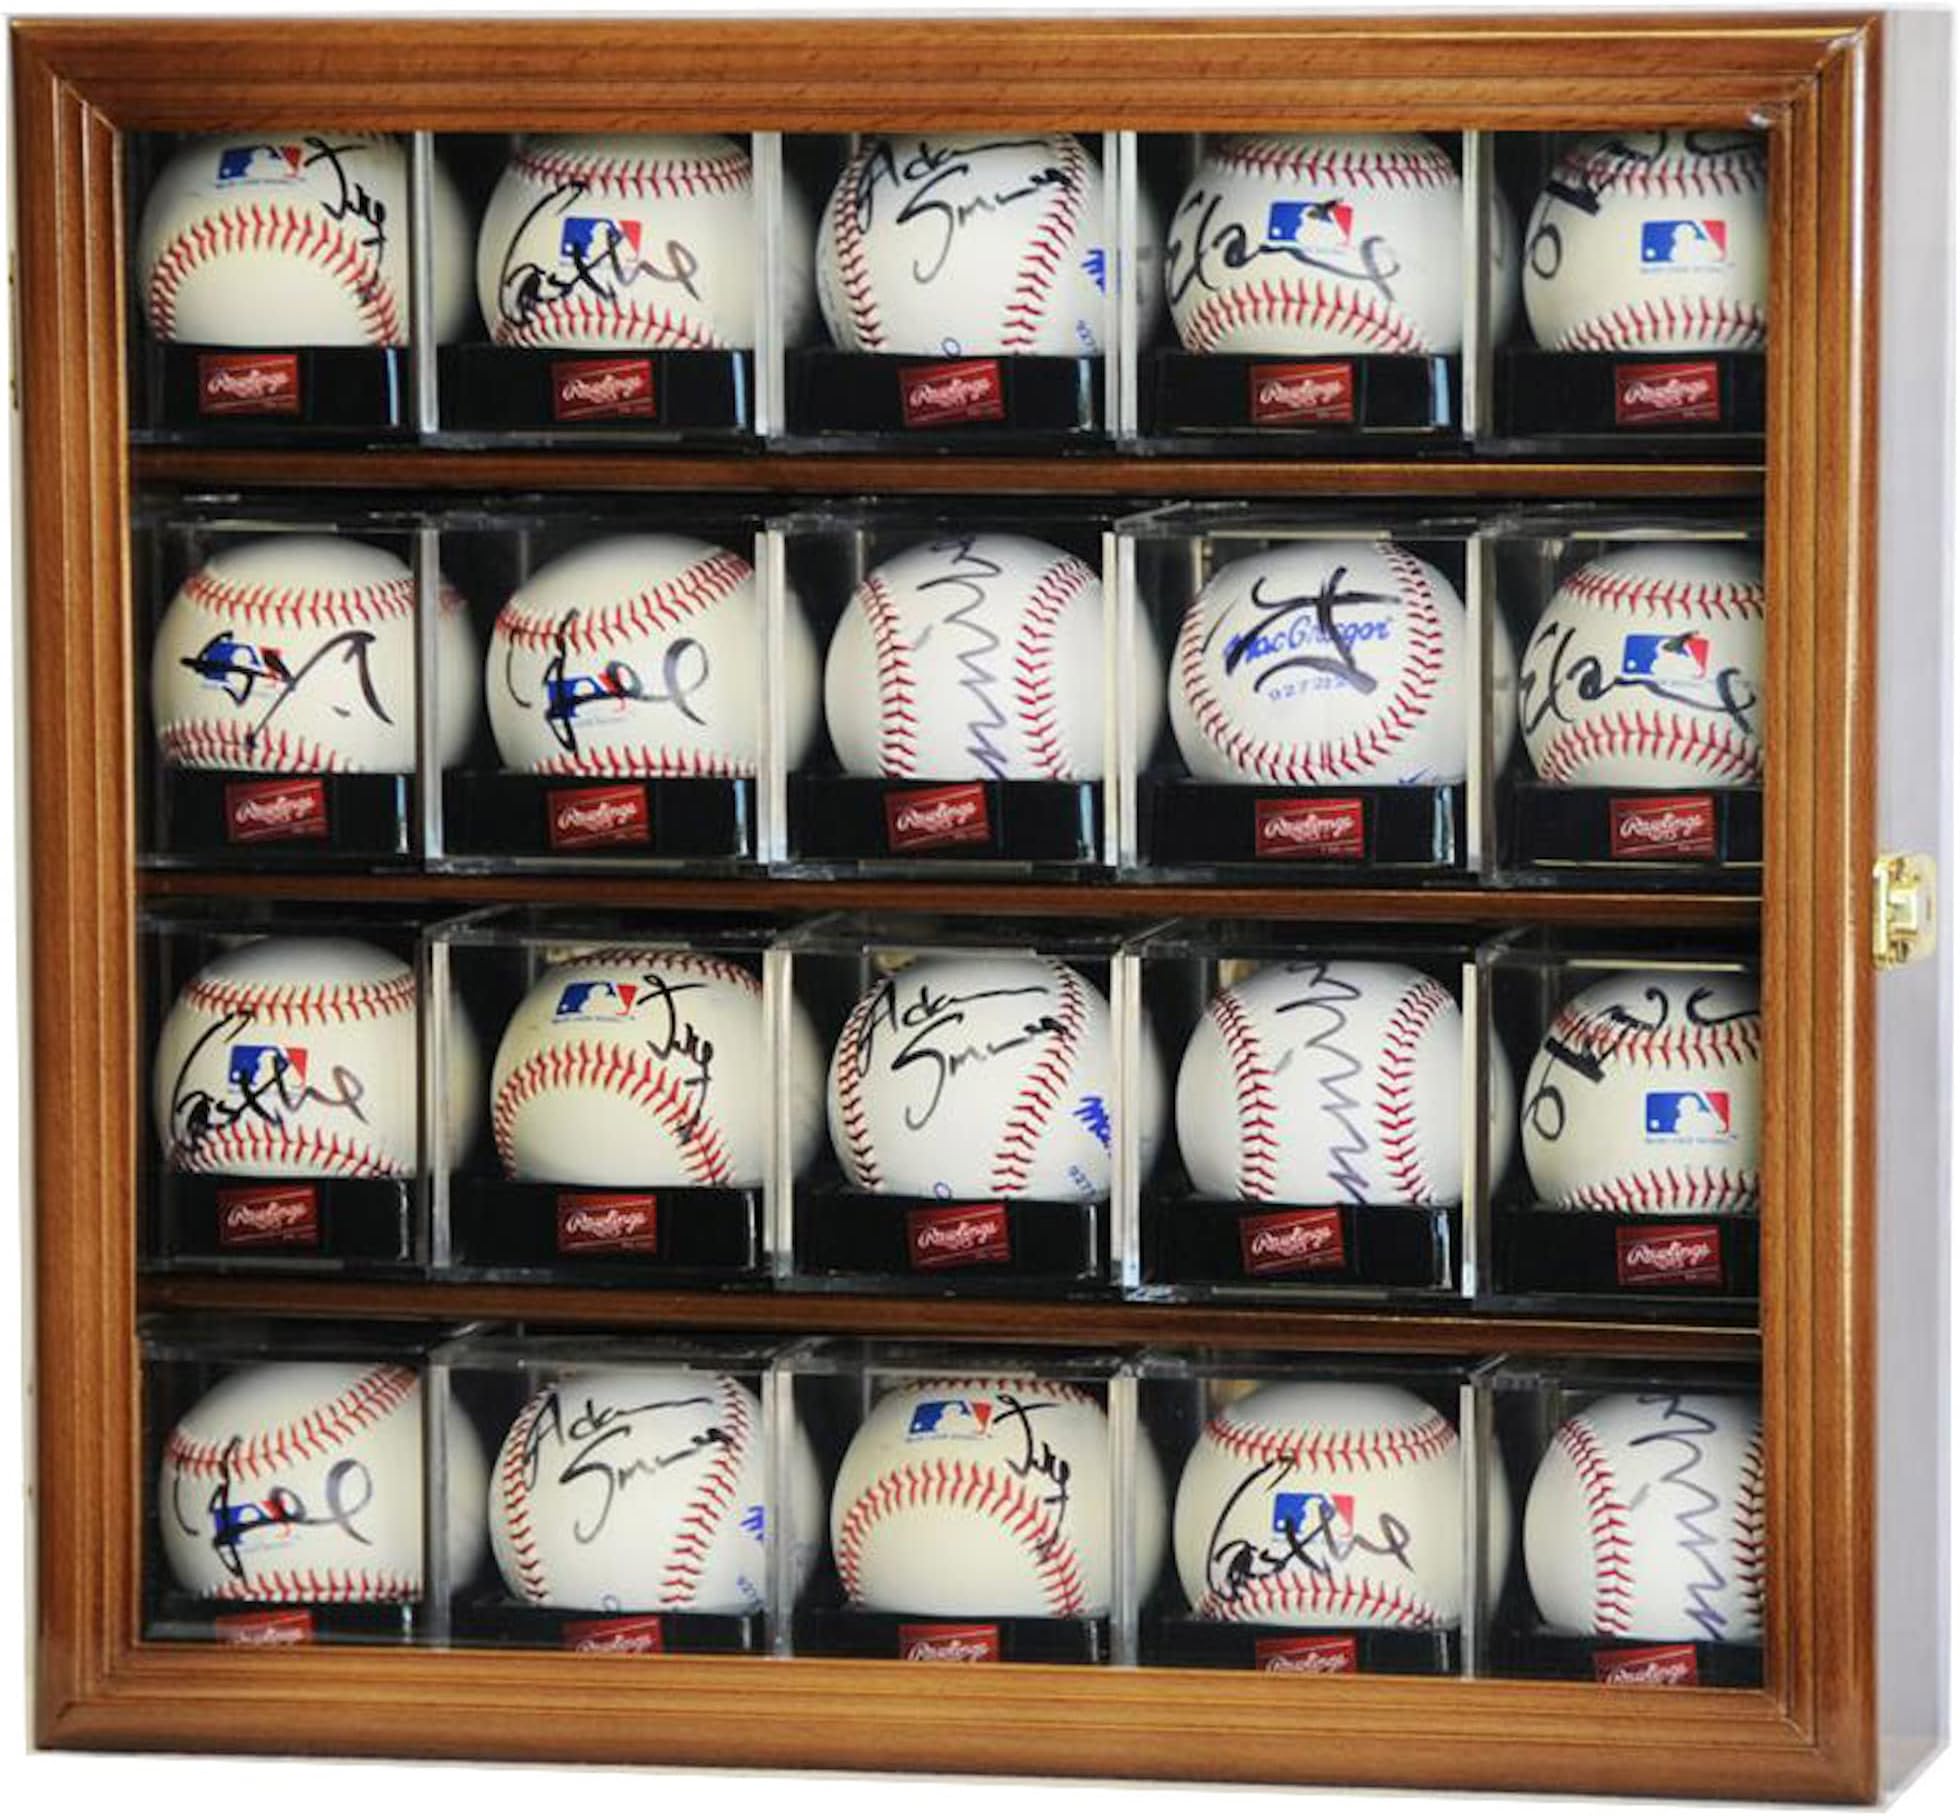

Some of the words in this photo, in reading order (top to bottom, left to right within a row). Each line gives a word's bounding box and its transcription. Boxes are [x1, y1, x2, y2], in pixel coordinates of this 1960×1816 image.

[207, 370, 290, 398] Rawlings
[562, 374, 645, 403] Rawlings
[909, 378, 990, 408] Rawlings
[1259, 379, 1344, 408] Rawlings
[1623, 379, 1709, 408] Rawlings
[235, 797, 316, 824] Rawlings
[557, 802, 638, 830] Rawlings
[896, 803, 976, 832] Rawlings
[1264, 814, 1354, 842] Rawlings
[1619, 813, 1705, 842] Rawlings
[227, 1202, 307, 1230] Rawlings
[566, 1210, 648, 1237] Rawlings
[917, 1222, 997, 1250] Rawlings
[1251, 1227, 1333, 1257] Rawlings
[1626, 1241, 1711, 1270] Rawlings
